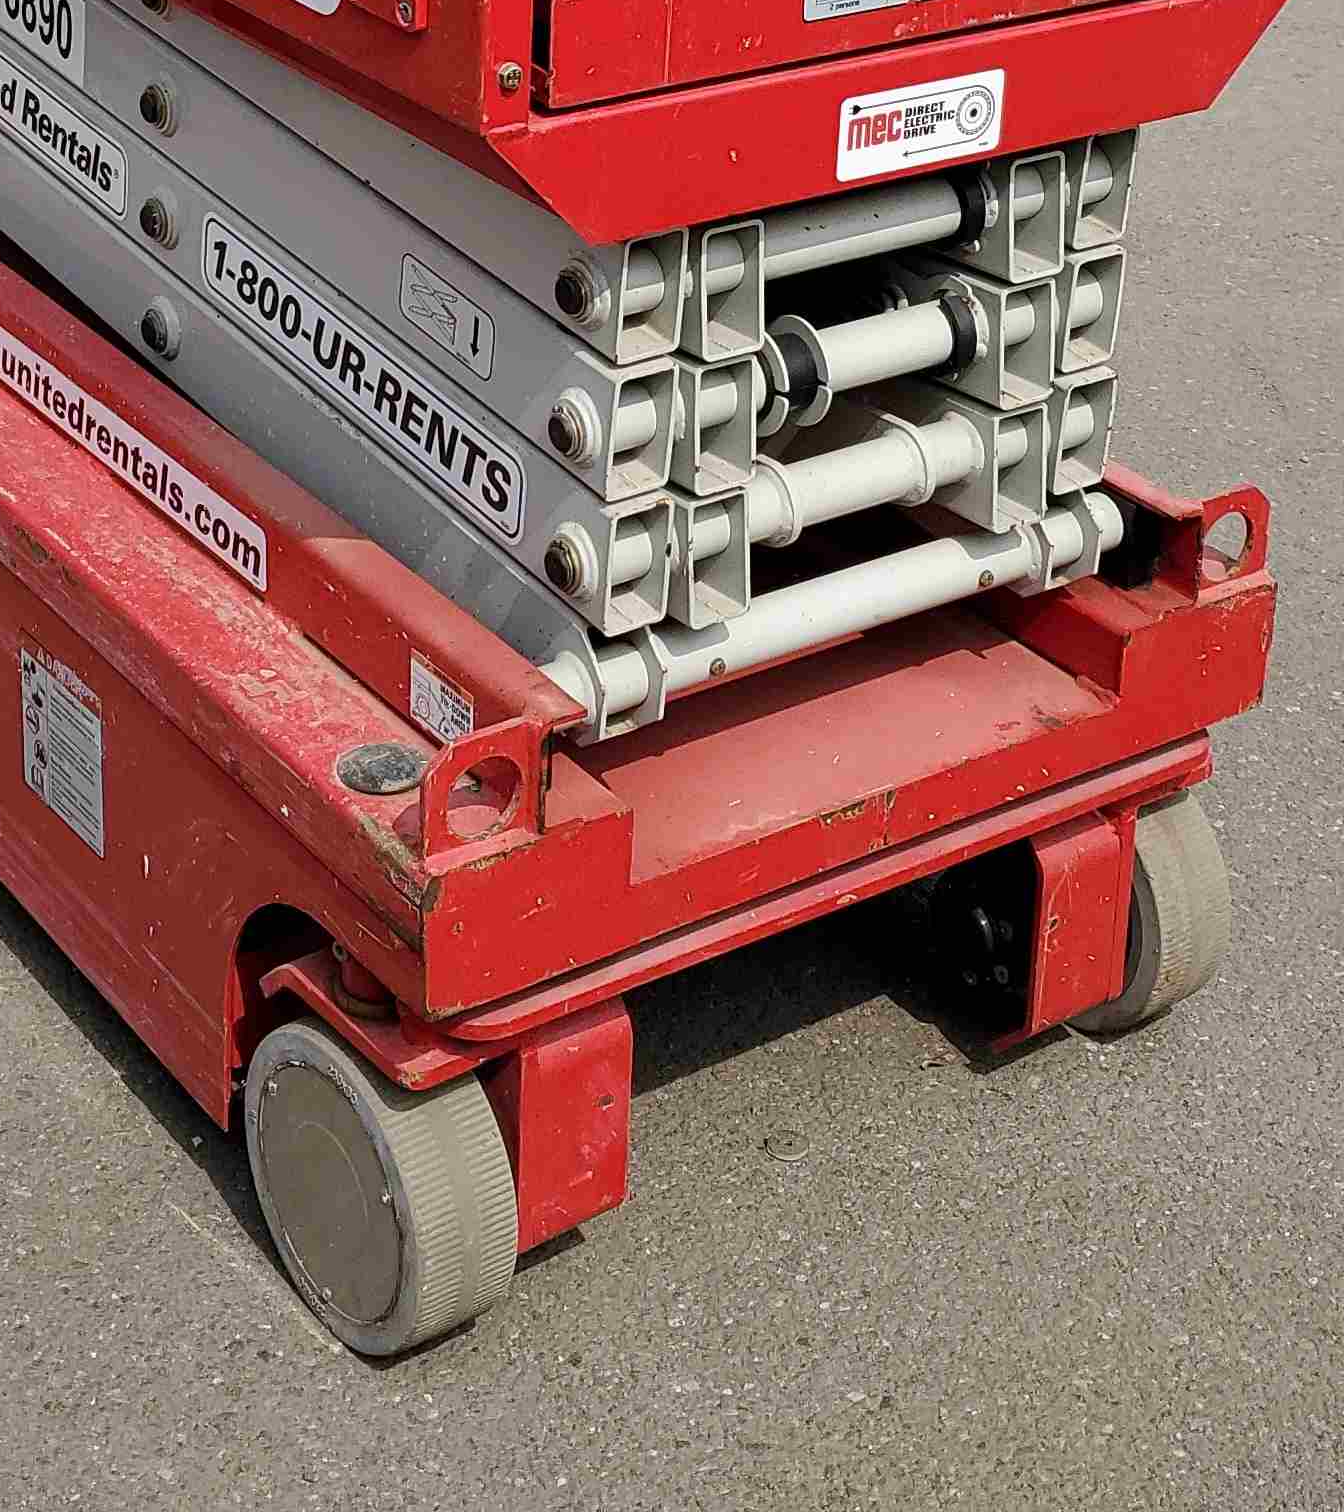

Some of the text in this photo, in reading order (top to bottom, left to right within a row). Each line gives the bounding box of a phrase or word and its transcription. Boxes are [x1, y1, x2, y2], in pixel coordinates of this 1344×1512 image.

[903, 109, 956, 129] ELECTRIC
[905, 100, 946, 118] DIRECT
[22, 96, 113, 193] Rentals
[846, 109, 903, 152] mec
[903, 123, 937, 140] DRIVE
[212, 240, 515, 514] 1-800-UR-RENTS
